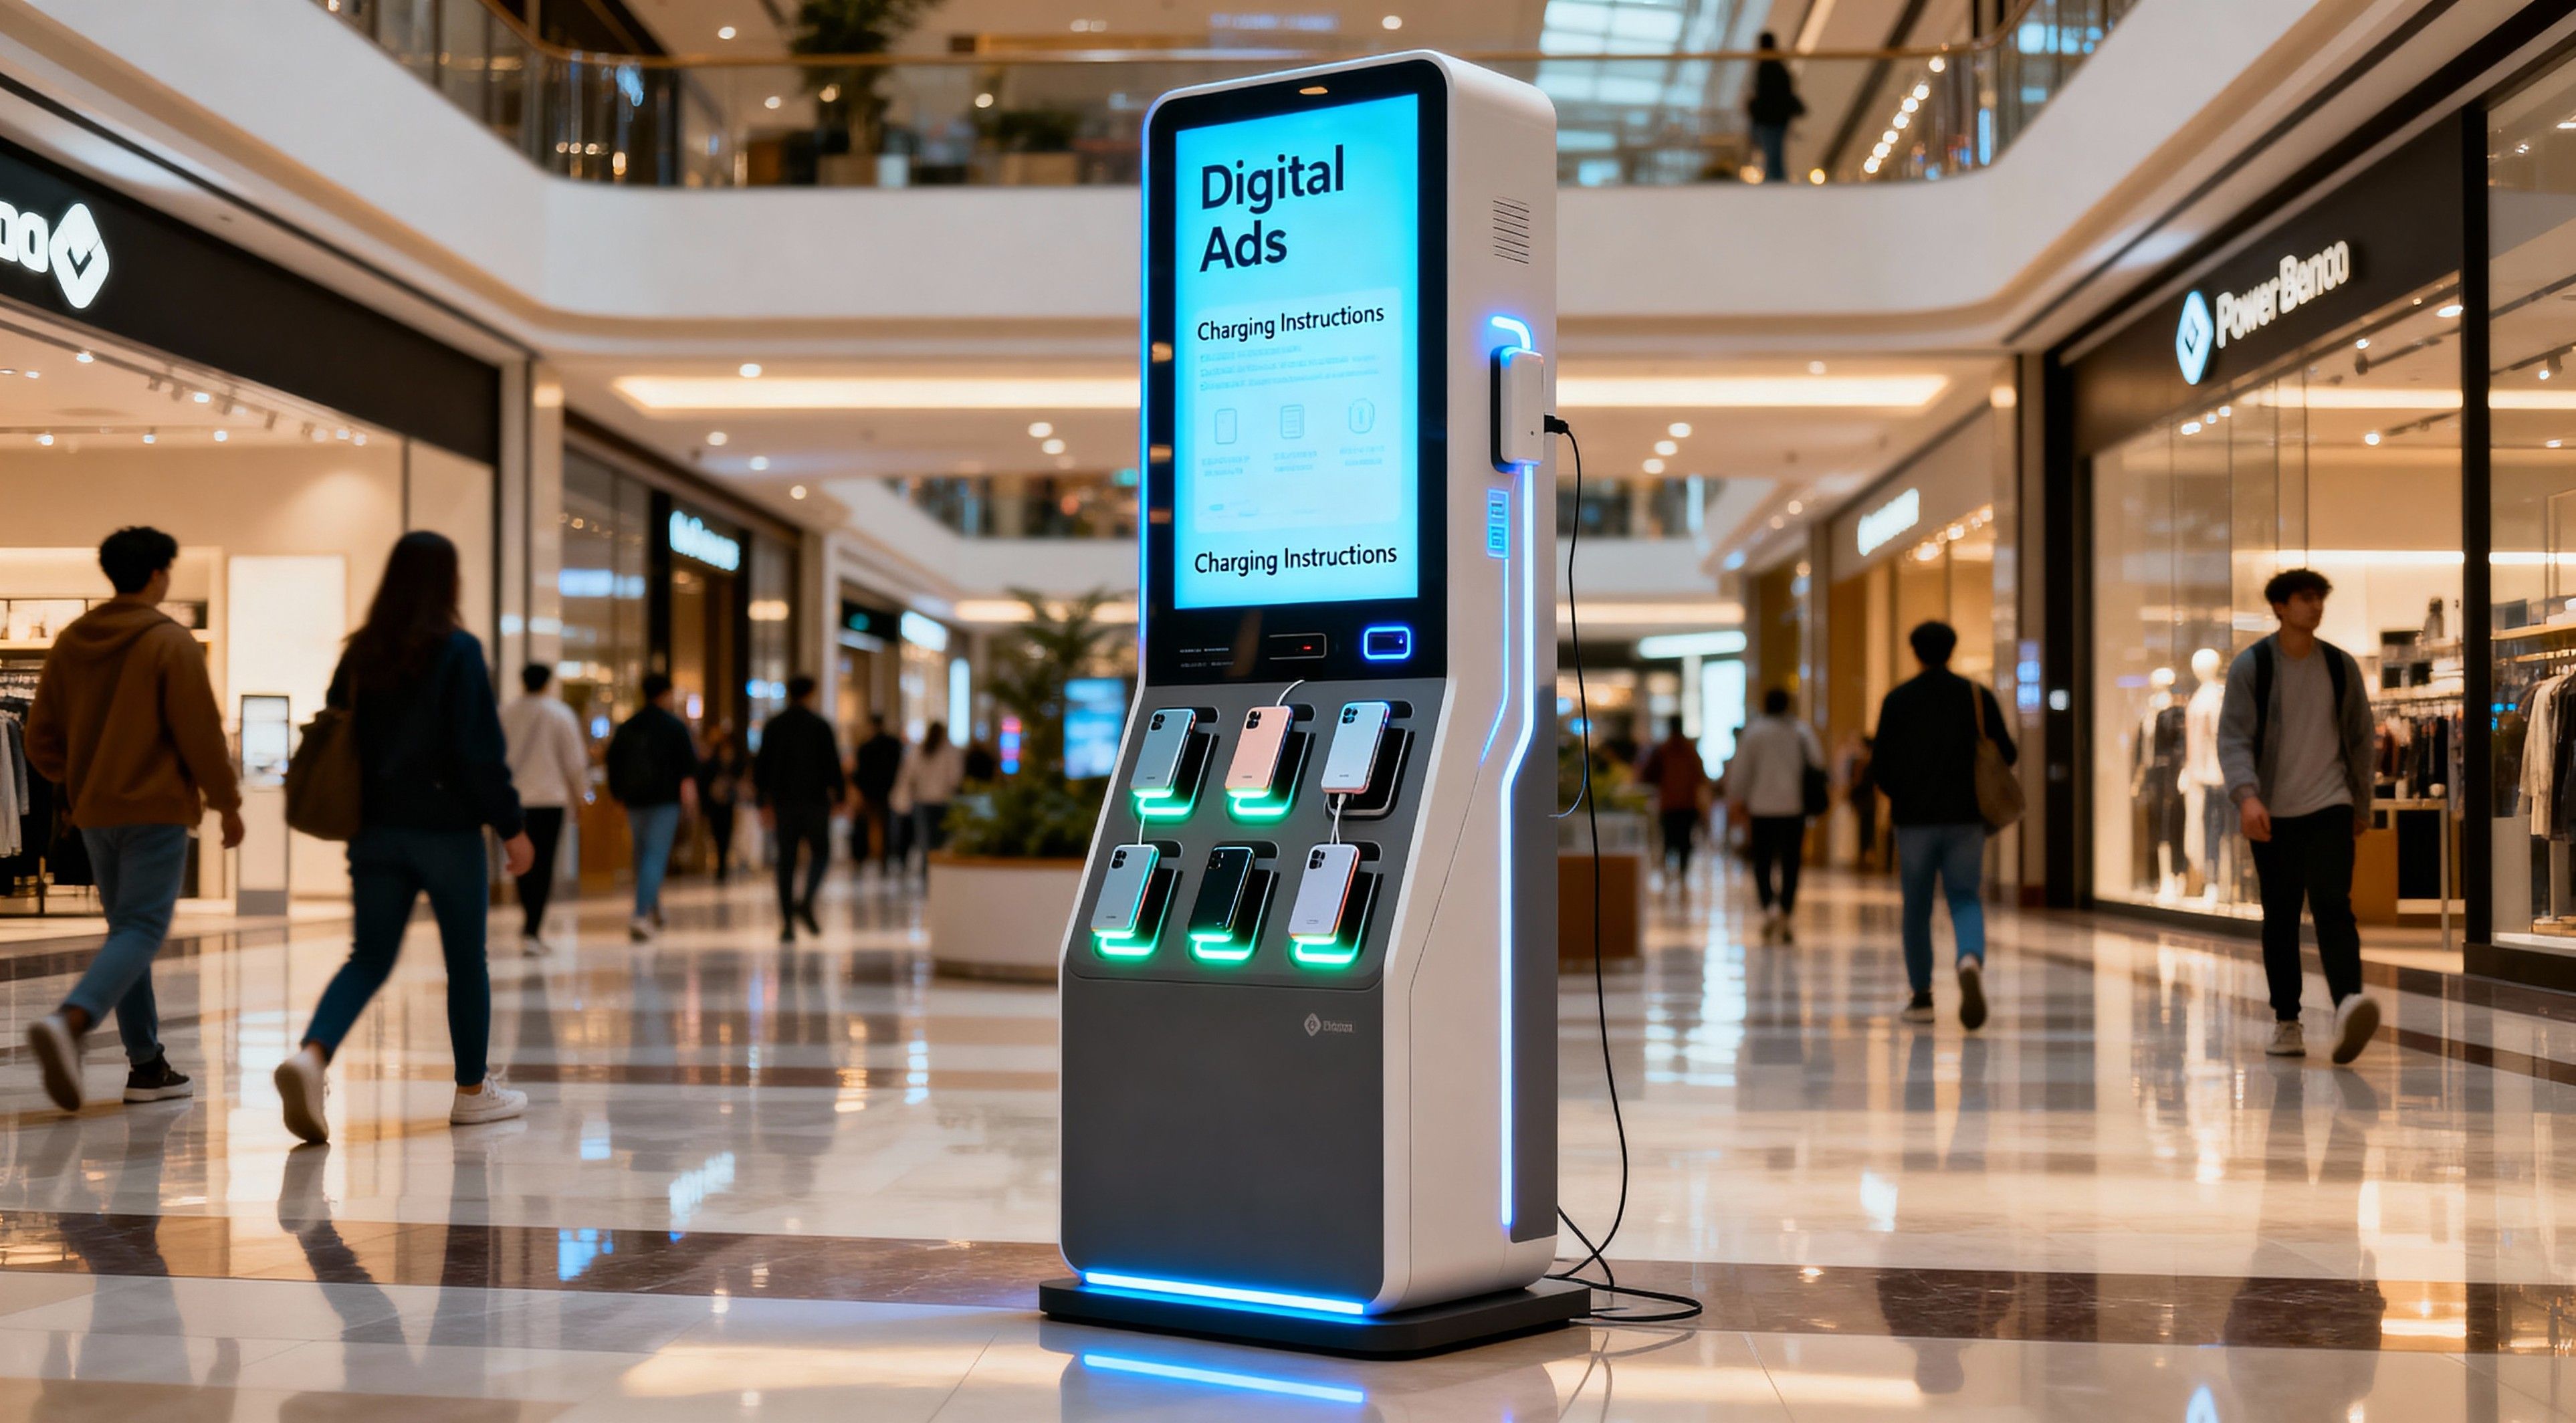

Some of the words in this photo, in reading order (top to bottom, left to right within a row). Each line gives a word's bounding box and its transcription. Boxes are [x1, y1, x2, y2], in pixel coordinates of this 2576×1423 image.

[1202, 144, 1344, 214] Digital
[1199, 220, 1287, 272] Ads
[1197, 316, 1275, 342] Charging
[1281, 305, 1384, 332] Instructions
[2216, 277, 2280, 349] Power
[1194, 549, 1277, 577] Charging
[1285, 543, 1397, 569] Instructions
